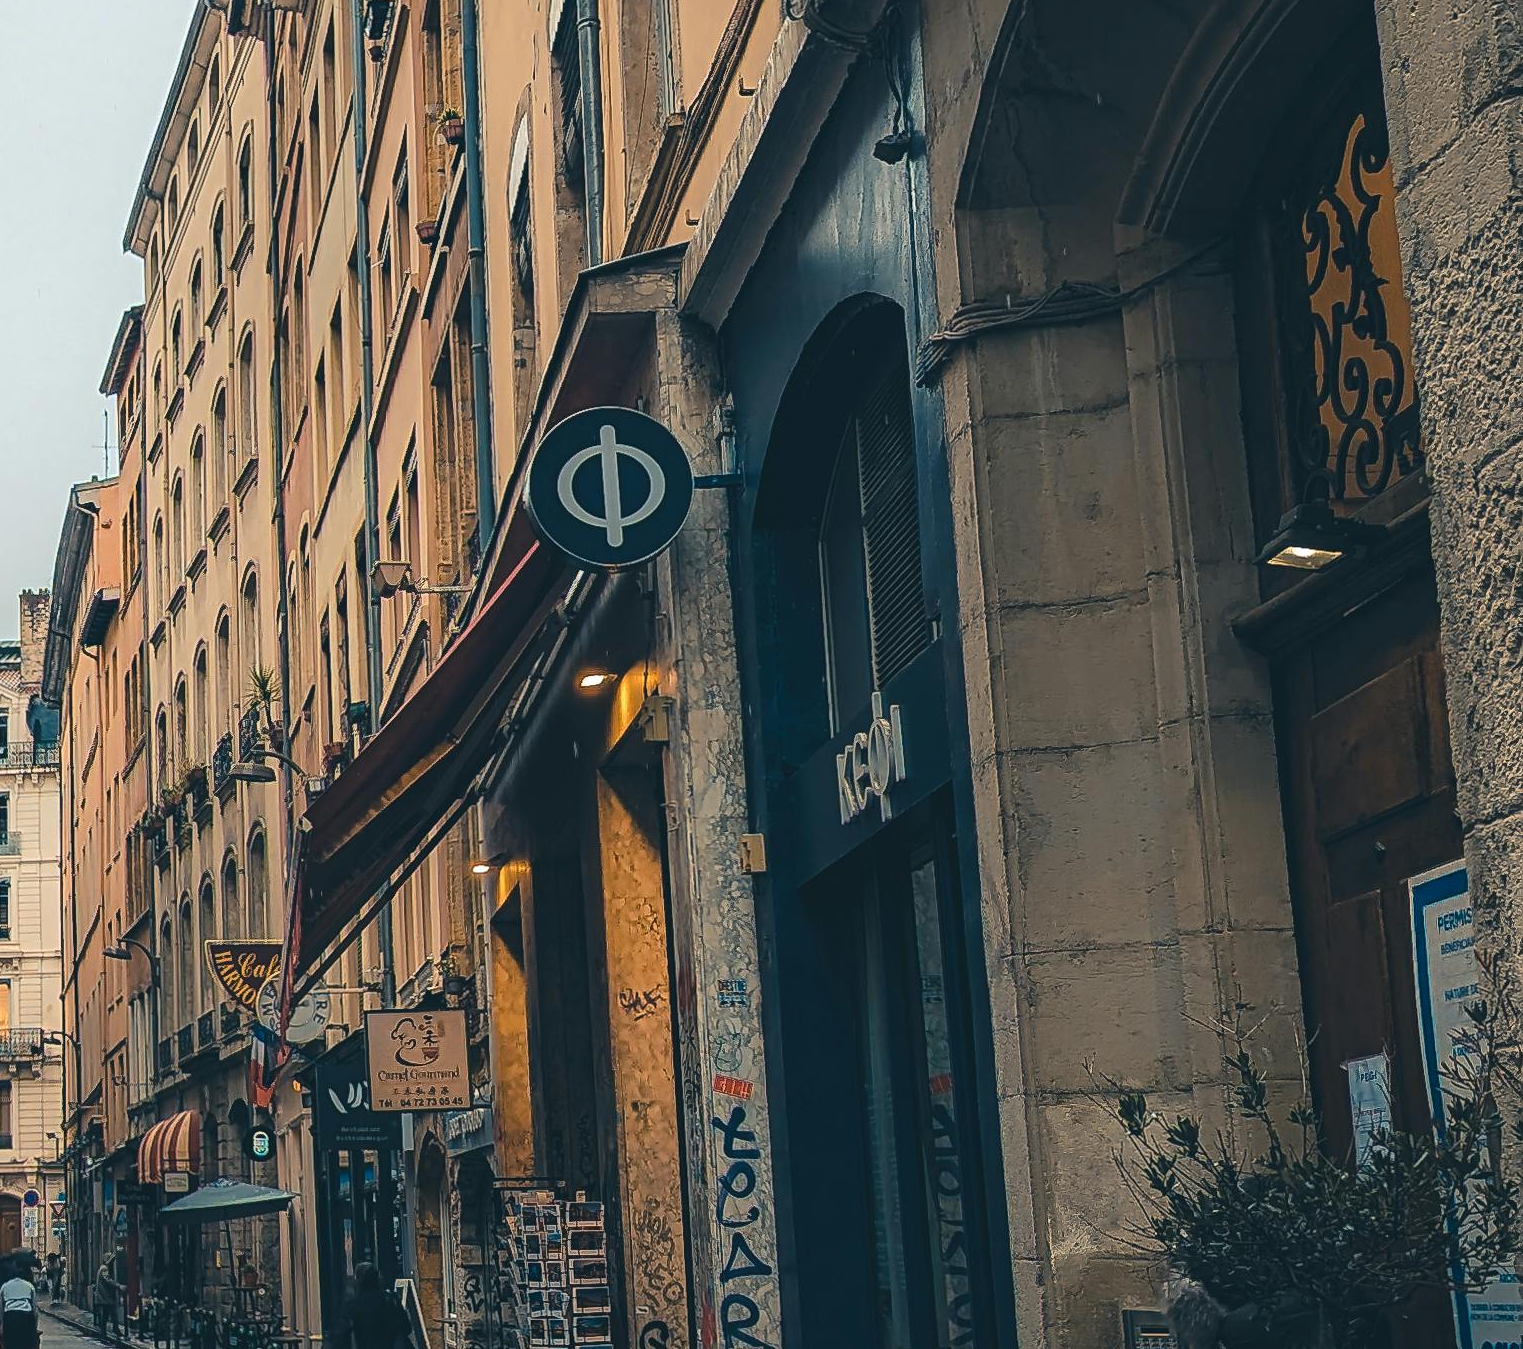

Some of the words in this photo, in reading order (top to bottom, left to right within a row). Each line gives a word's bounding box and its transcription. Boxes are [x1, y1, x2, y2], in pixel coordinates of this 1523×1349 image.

[214, 950, 258, 1009] HARMO
[400, 1098, 412, 1107] 04
[413, 1098, 425, 1107] 72
[426, 1097, 438, 1106] 73
[452, 1096, 464, 1105] 45
